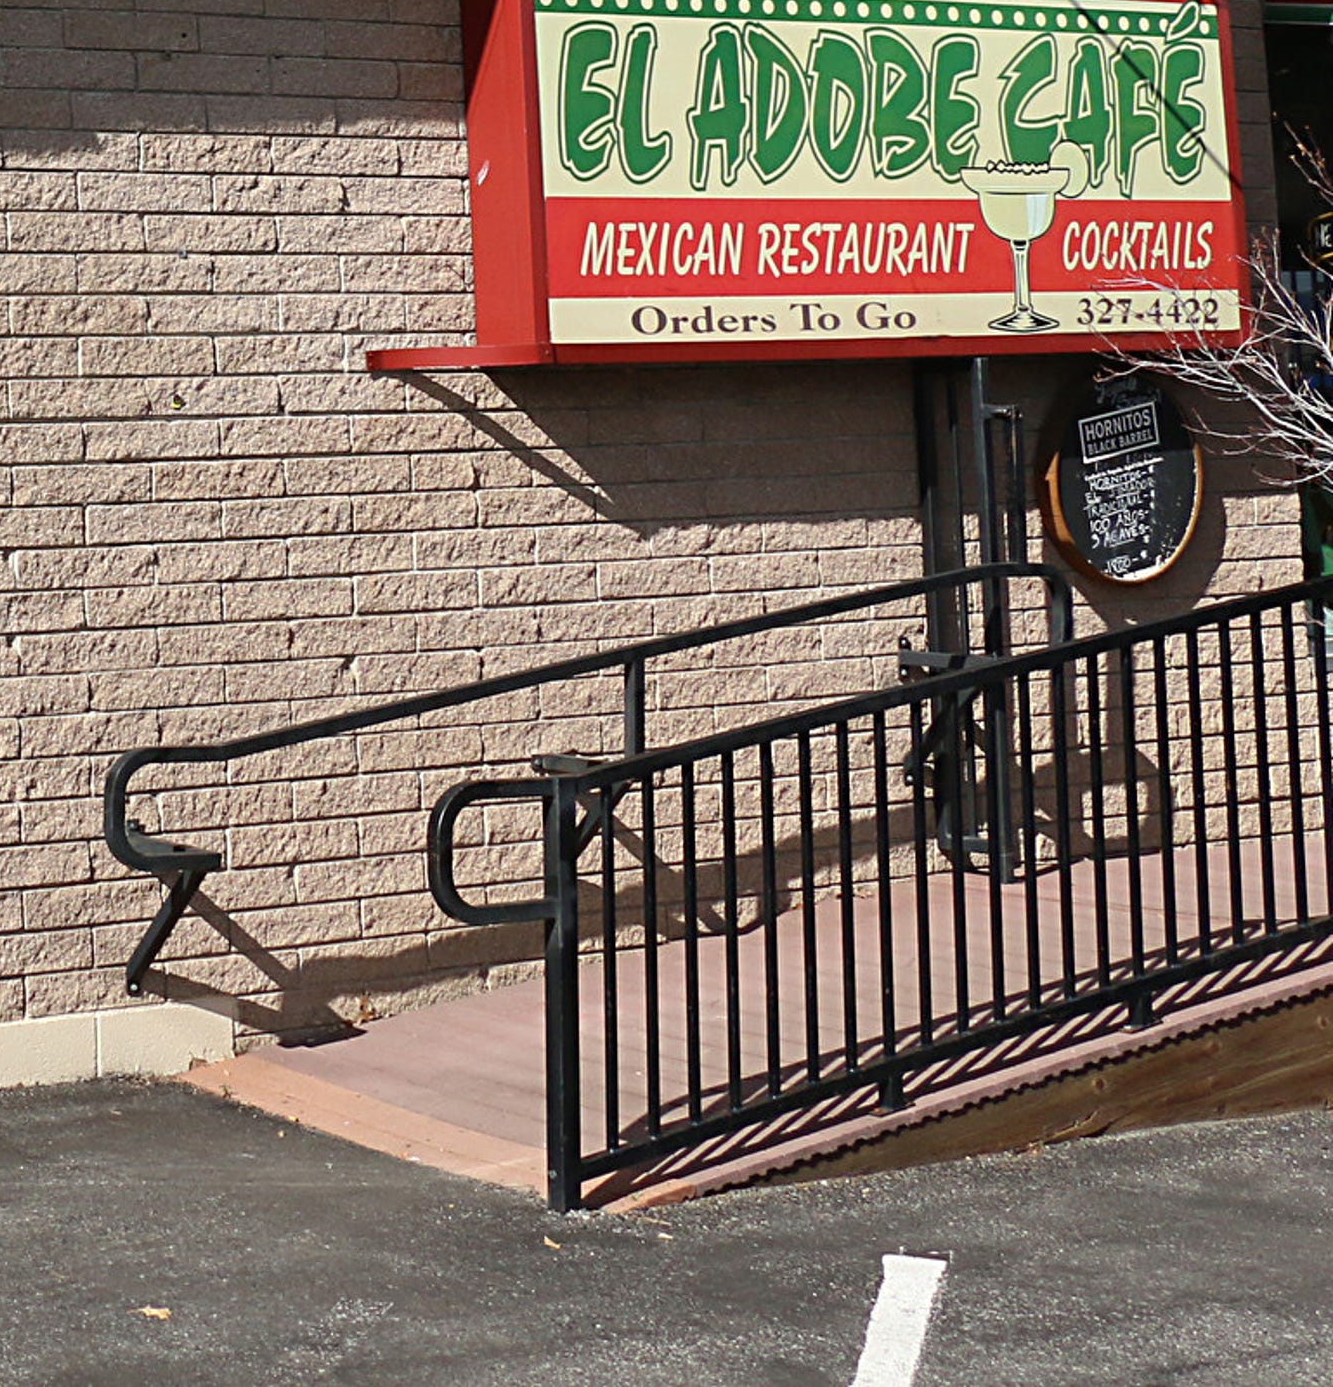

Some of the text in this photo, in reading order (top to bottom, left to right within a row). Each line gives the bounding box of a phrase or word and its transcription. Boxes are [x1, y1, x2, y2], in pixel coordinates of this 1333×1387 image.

[559, 0, 1206, 198] EL ADOBE CAFÉ
[580, 221, 975, 278] MEXICAN RESTAURANT
[1062, 220, 1214, 272] COCKTAILS
[632, 300, 917, 336] Orders To Go
[1076, 297, 1219, 326] 327-4422
[1085, 410, 1152, 442] HORNITOS
[1088, 429, 1153, 455] BLACK BARREL
